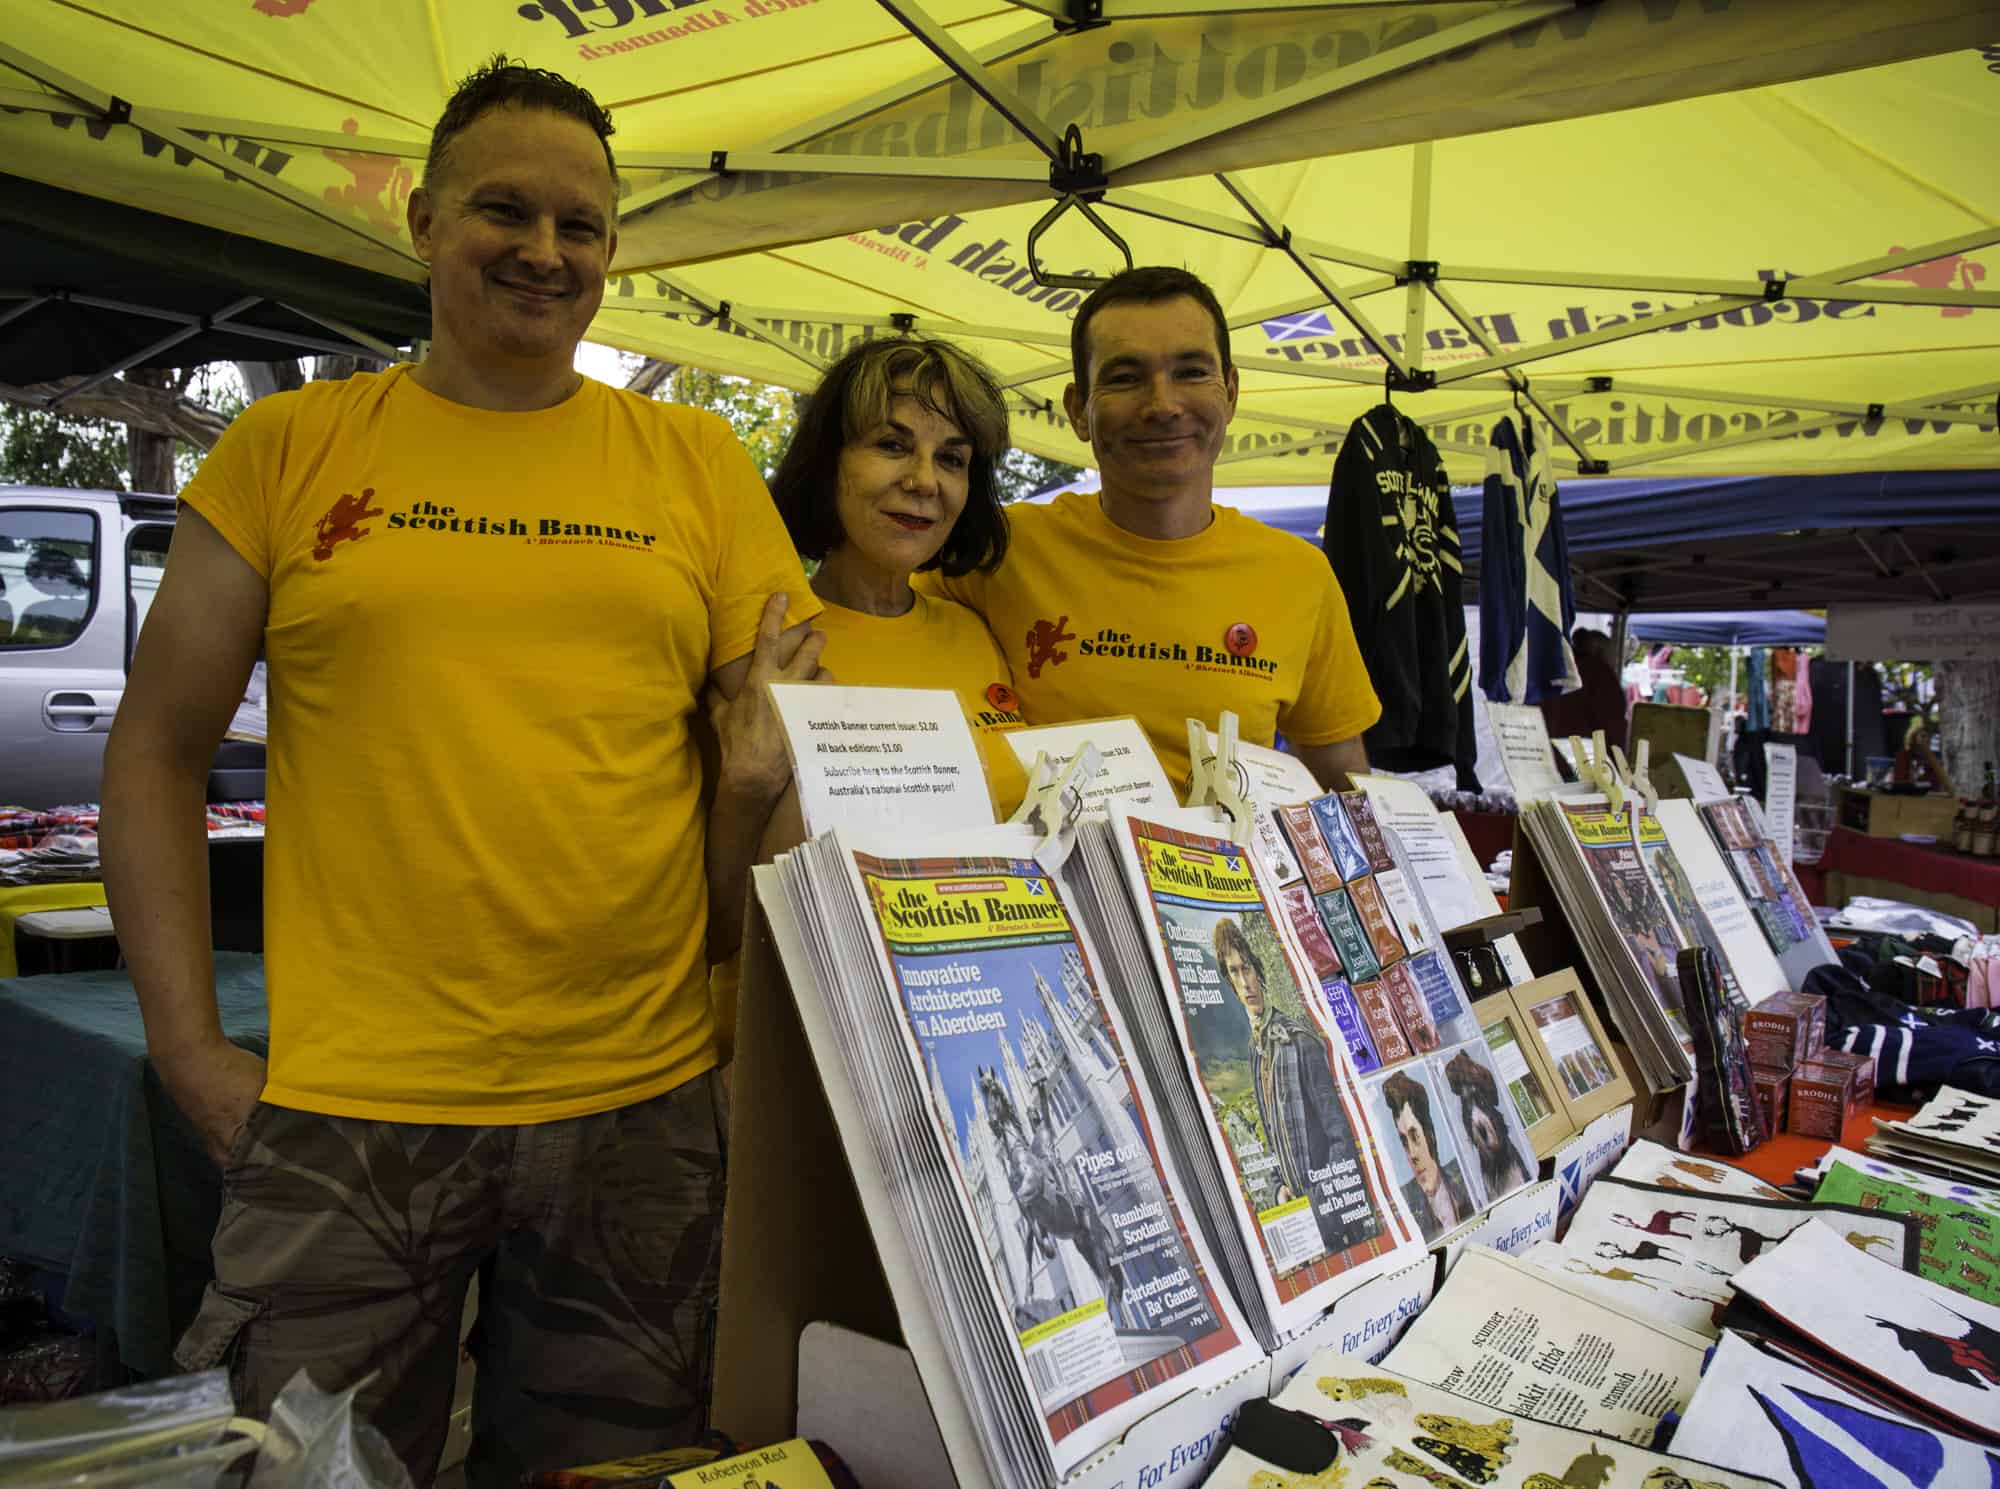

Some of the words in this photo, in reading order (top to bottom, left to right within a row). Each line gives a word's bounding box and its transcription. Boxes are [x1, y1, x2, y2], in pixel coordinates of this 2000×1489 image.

[412, 501, 456, 516] the
[387, 512, 528, 536] Scottish
[539, 519, 656, 546] Banner
[1097, 629, 1132, 643] the
[1079, 639, 1187, 661] Scottish
[1196, 646, 1278, 673] Banner
[808, 720, 840, 731] Scottish
[841, 721, 869, 731] Banner
[869, 721, 896, 731] current
[816, 743, 828, 753] All
[828, 743, 848, 753] back
[848, 743, 882, 753] editions:
[882, 743, 904, 753] $1.00
[823, 765, 861, 777] Subscribe
[862, 765, 880, 776] here
[880, 766, 890, 776] to
[890, 765, 903, 775] the
[903, 764, 932, 775] Scottish
[828, 784, 871, 796] Australia's
[871, 785, 902, 795] national
[902, 781, 931, 793] Scottish
[1161, 848, 1177, 866] the
[1155, 860, 1203, 888] Scottish
[1203, 869, 1253, 891] Banner
[897, 887, 928, 909] the
[888, 899, 982, 929] Scottish
[983, 897, 1059, 922] Banner
[898, 961, 982, 987] Innovative
[1177, 963, 1197, 983] with
[1197, 965, 1220, 984] Sam
[908, 986, 1003, 1012] Architecture
[914, 1013, 930, 1037] in
[930, 1009, 1007, 1037] Aberdeen
[1075, 1151, 1115, 1176] Pipes
[1585, 1150, 1596, 1167] For
[1595, 1139, 1612, 1159] Every
[1111, 1200, 1164, 1229] Rambling
[1123, 1215, 1170, 1246] Scotland
[1496, 1235, 1509, 1252] For
[1510, 1222, 1534, 1248] Every
[1122, 1265, 1191, 1305] Carterhaugh
[1145, 1297, 1163, 1317] Ba'
[1163, 1285, 1198, 1309] Game
[1342, 1331, 1362, 1355] For
[1363, 1310, 1396, 1343] Every
[1471, 1311, 1505, 1348] scunner
[1432, 1365, 1466, 1392] braw
[1600, 1372, 1636, 1410] stramash
[696, 1458, 762, 1485] Robertson
[760, 1447, 787, 1465] Red
[1138, 1461, 1166, 1489] For
[1168, 1429, 1217, 1475] Every
